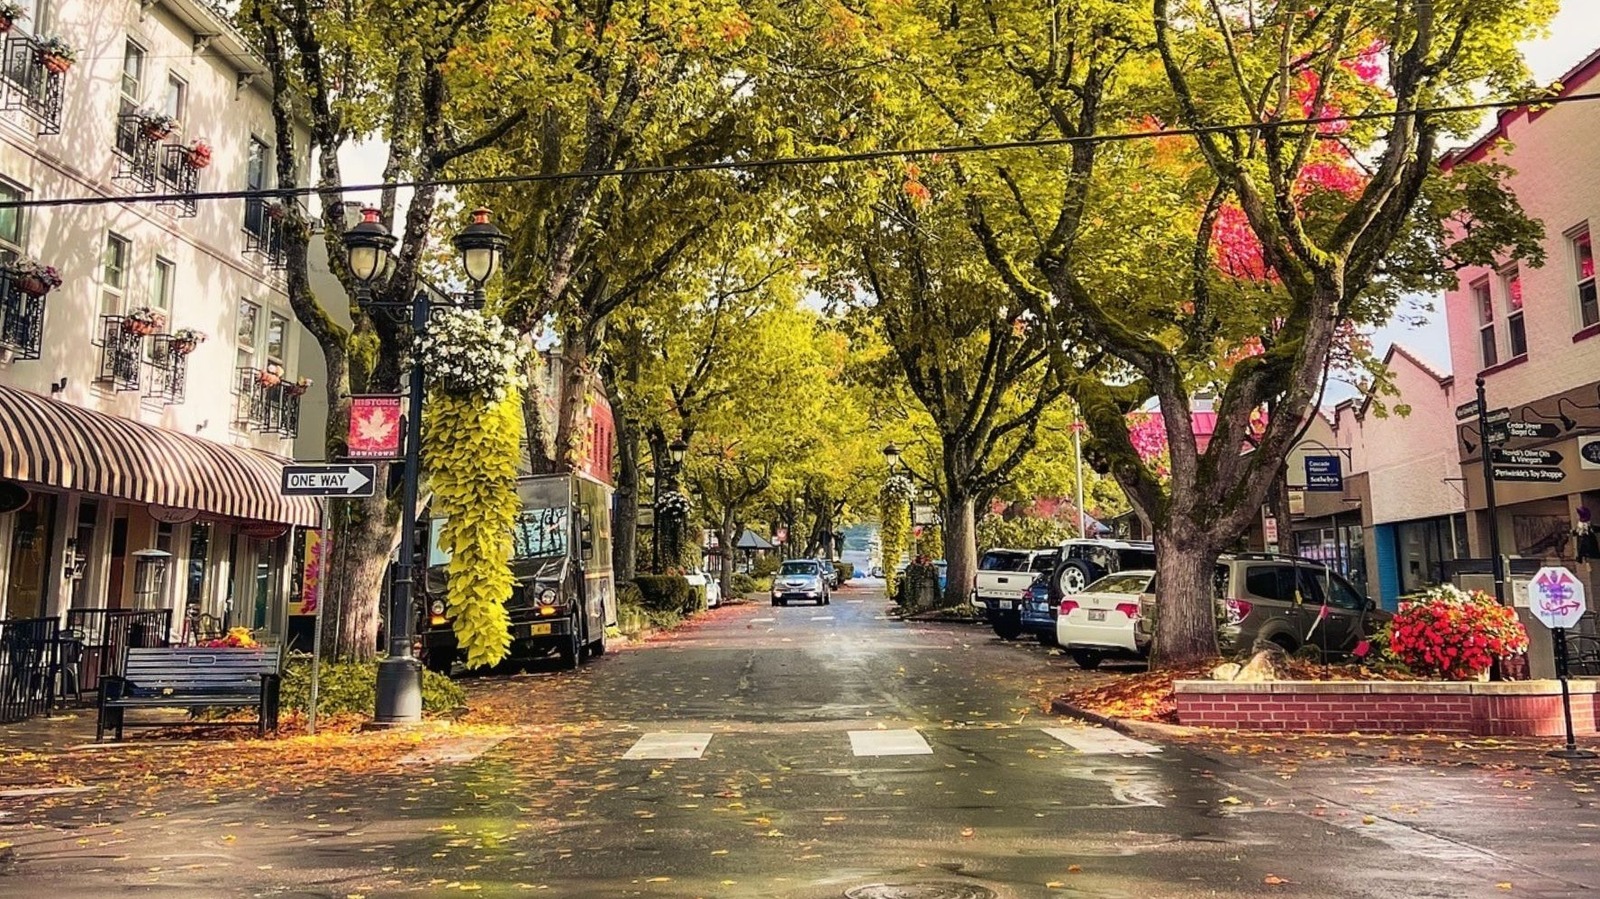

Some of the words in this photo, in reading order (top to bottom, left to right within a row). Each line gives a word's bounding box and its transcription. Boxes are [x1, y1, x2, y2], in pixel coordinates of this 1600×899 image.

[354, 398, 400, 406] HISTORIC
[1506, 421, 1524, 429] Cedar
[1524, 449, 1538, 457] Olive
[1538, 449, 1551, 457] Oils
[1517, 456, 1543, 464] Vinegars
[1495, 469, 1529, 477] Periwinkle's
[1529, 469, 1540, 478] Toy
[1540, 470, 1563, 478] Shoppe
[291, 475, 316, 487] ONE
[320, 475, 347, 487] WAY
